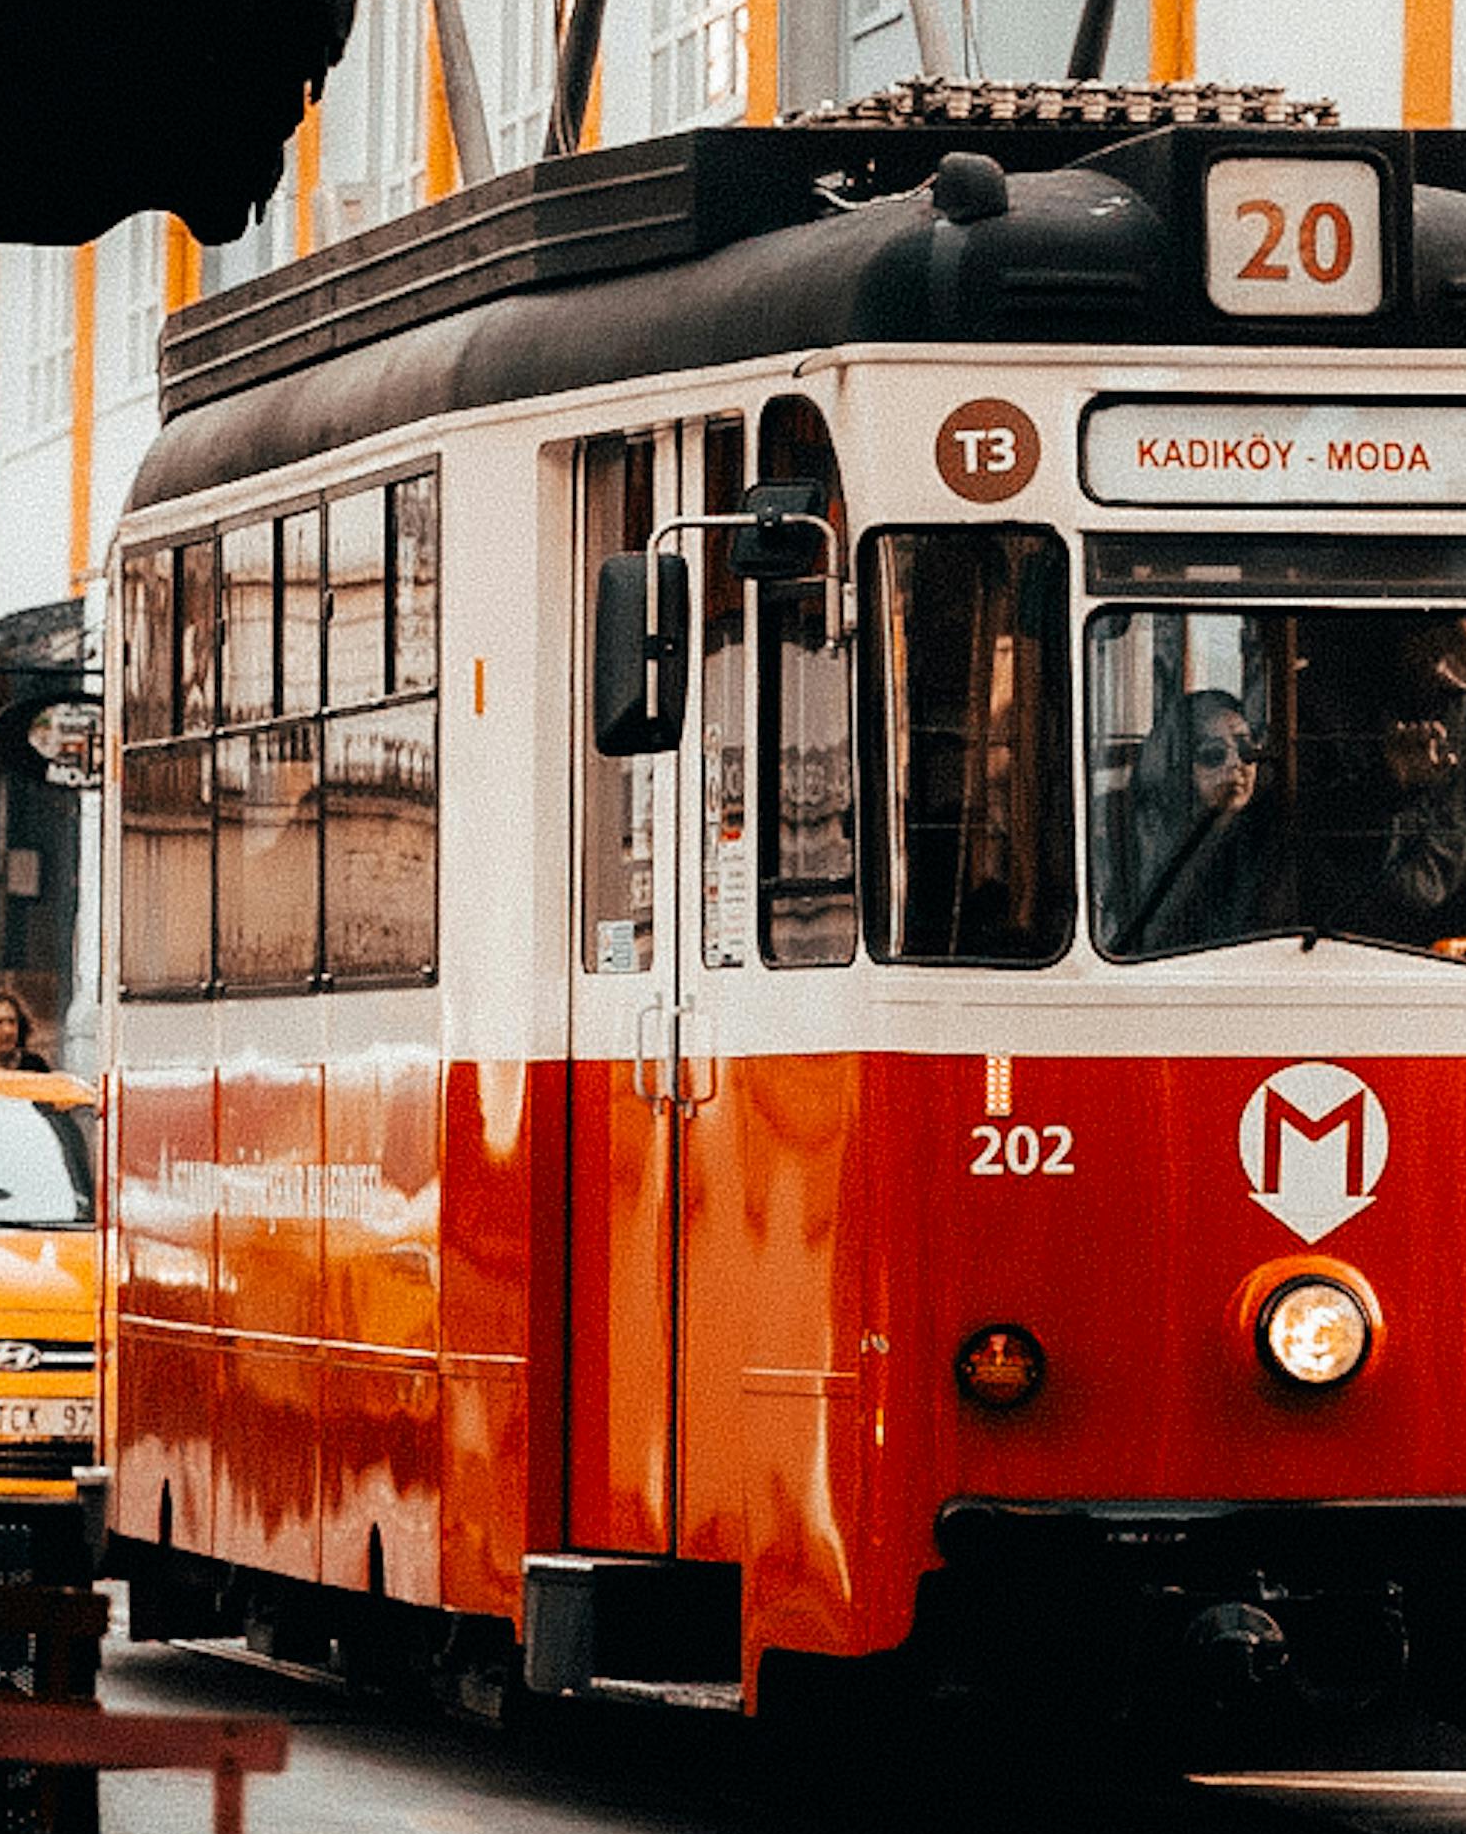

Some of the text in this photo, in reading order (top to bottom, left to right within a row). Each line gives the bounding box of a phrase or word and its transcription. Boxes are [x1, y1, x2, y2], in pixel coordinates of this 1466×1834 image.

[1234, 199, 1354, 284] 20
[955, 427, 1018, 474] T3
[1136, 432, 1294, 472] KADIKÖY
[1326, 441, 1431, 473] MODA
[969, 1125, 1075, 1176] 202
